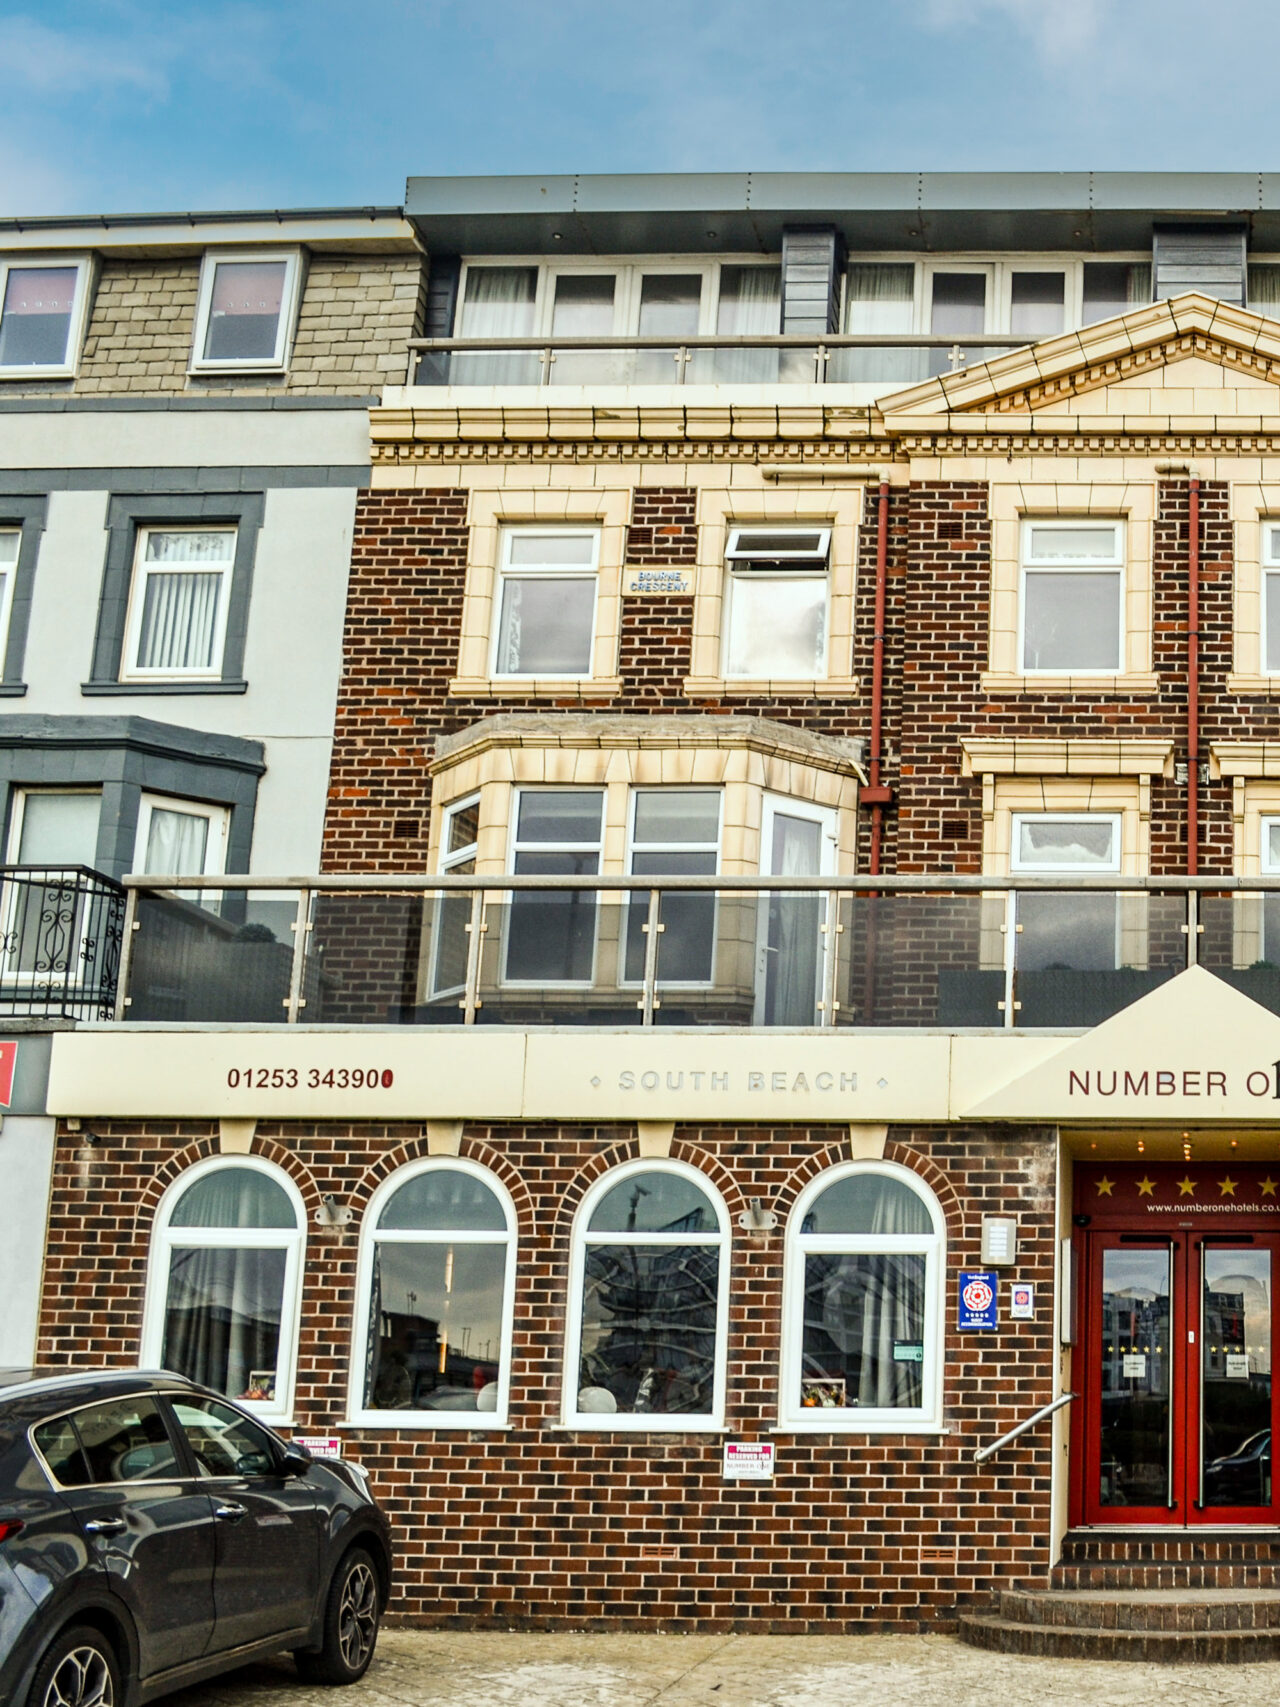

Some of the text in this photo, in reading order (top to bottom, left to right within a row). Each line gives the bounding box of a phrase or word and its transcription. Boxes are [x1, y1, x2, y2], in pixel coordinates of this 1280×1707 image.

[638, 572, 682, 582] BOURNE
[227, 1068, 394, 1089] 01253 343900
[618, 1070, 858, 1092] SOUTH BEACH
[1069, 1070, 1228, 1096] NUMBER
[736, 1445, 763, 1453] PARKING
